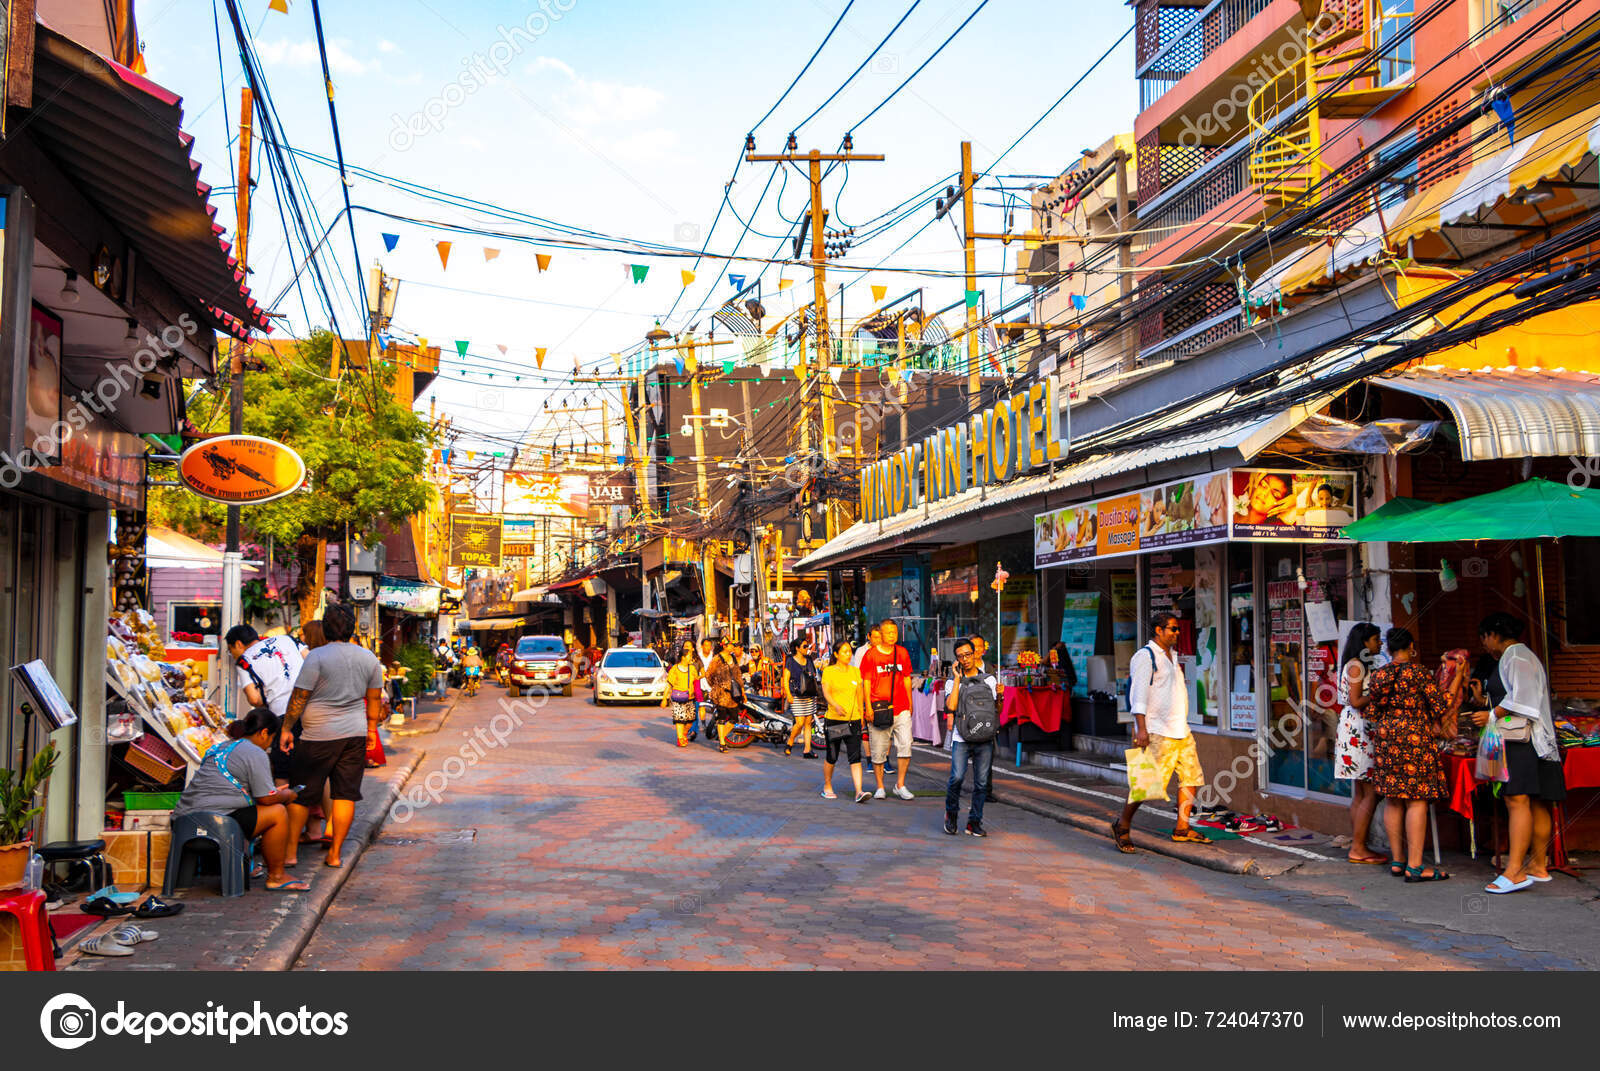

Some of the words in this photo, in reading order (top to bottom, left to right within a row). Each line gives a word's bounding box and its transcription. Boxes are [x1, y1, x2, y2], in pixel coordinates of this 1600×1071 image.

[860, 443, 921, 523] WINDY
[924, 422, 967, 503] INN
[971, 375, 1069, 487] HOTEL
[1098, 505, 1128, 528] Dusita's
[1107, 529, 1136, 546] Massage
[460, 551, 492, 562] TOPAZ
